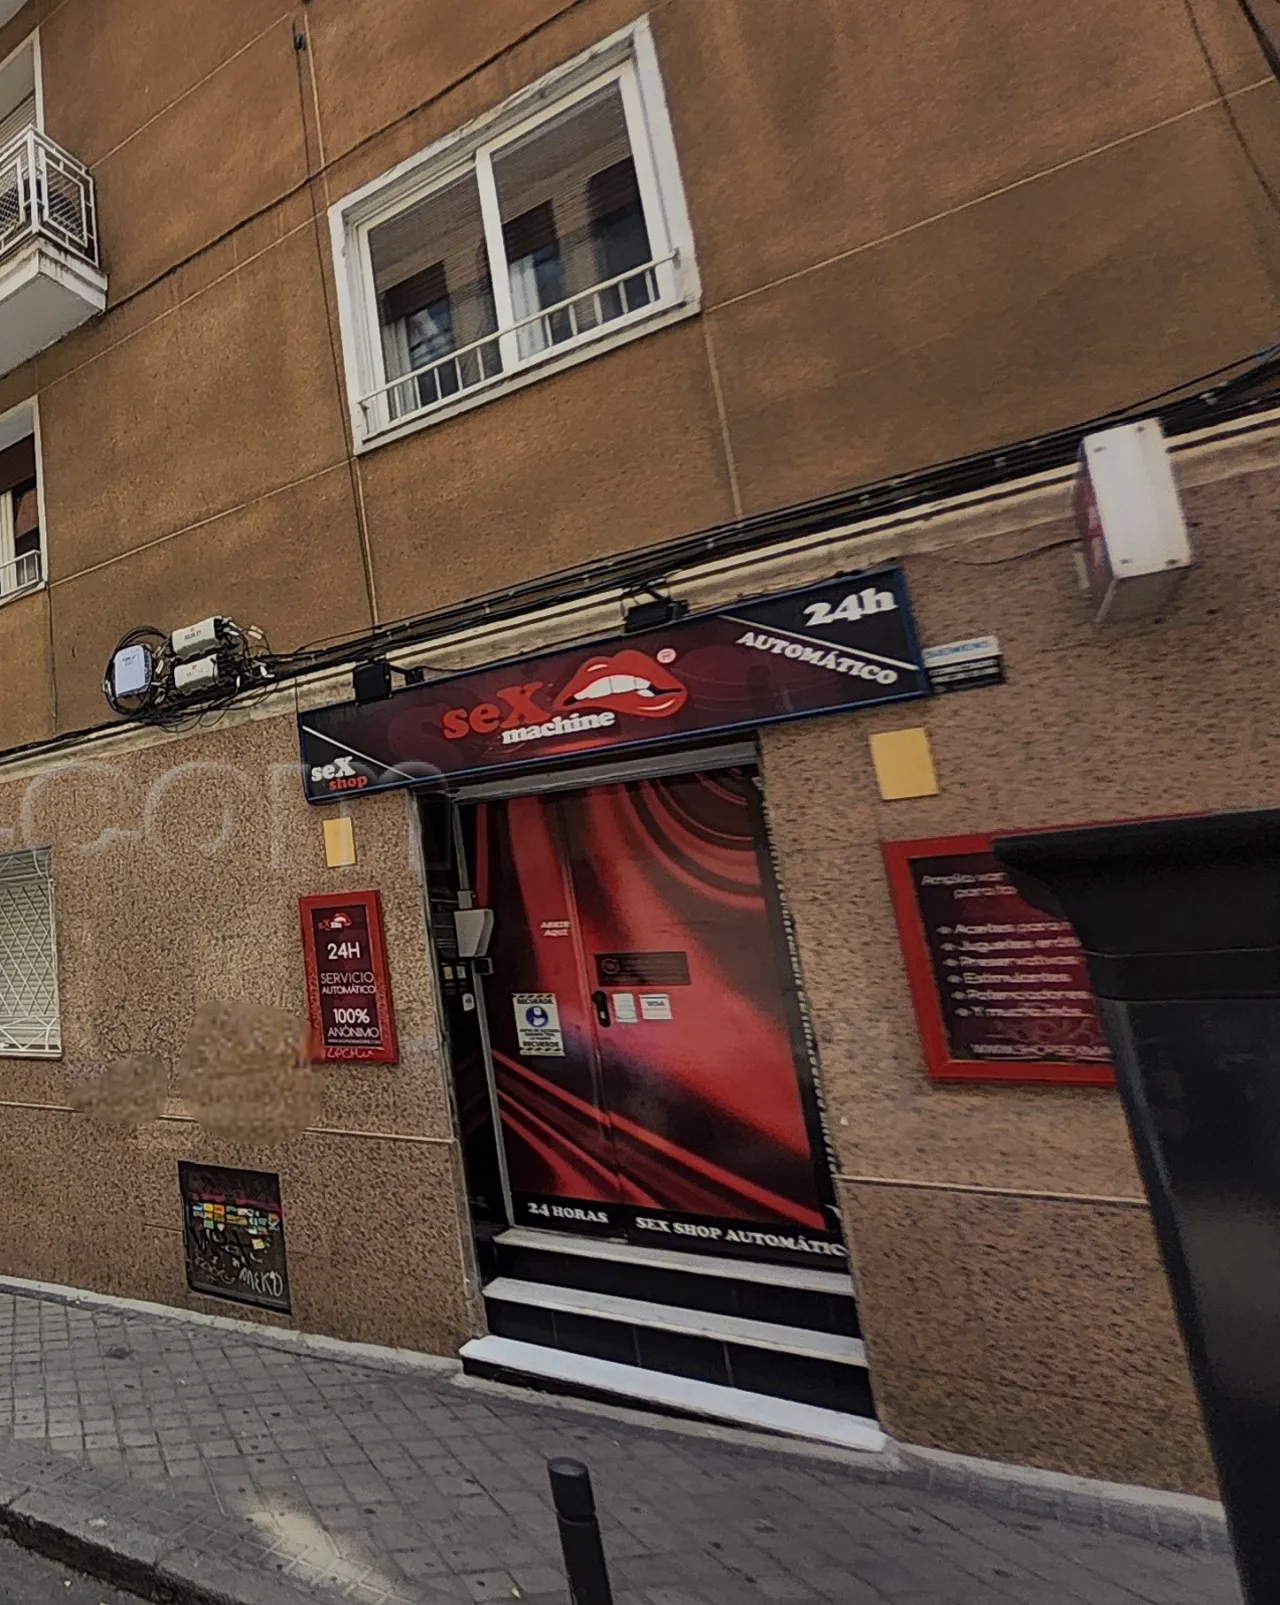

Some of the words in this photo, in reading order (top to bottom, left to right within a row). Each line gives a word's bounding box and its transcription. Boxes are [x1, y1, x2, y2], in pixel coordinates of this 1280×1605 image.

[802, 587, 899, 627] 24h
[735, 631, 899, 685] AUTOMÁTICO
[502, 710, 616, 745] machine
[328, 773, 368, 791] shop
[327, 941, 361, 960] 24H
[321, 971, 375, 985] SERVICIO
[321, 983, 376, 995] AUTOMÁTICO
[332, 1008, 370, 1024] 100%
[327, 1023, 380, 1038] ANÓNIMO
[528, 1202, 550, 1217] 24
[552, 1206, 610, 1224] HORAS
[635, 1216, 672, 1234] SEX
[673, 1222, 721, 1240] SHOP
